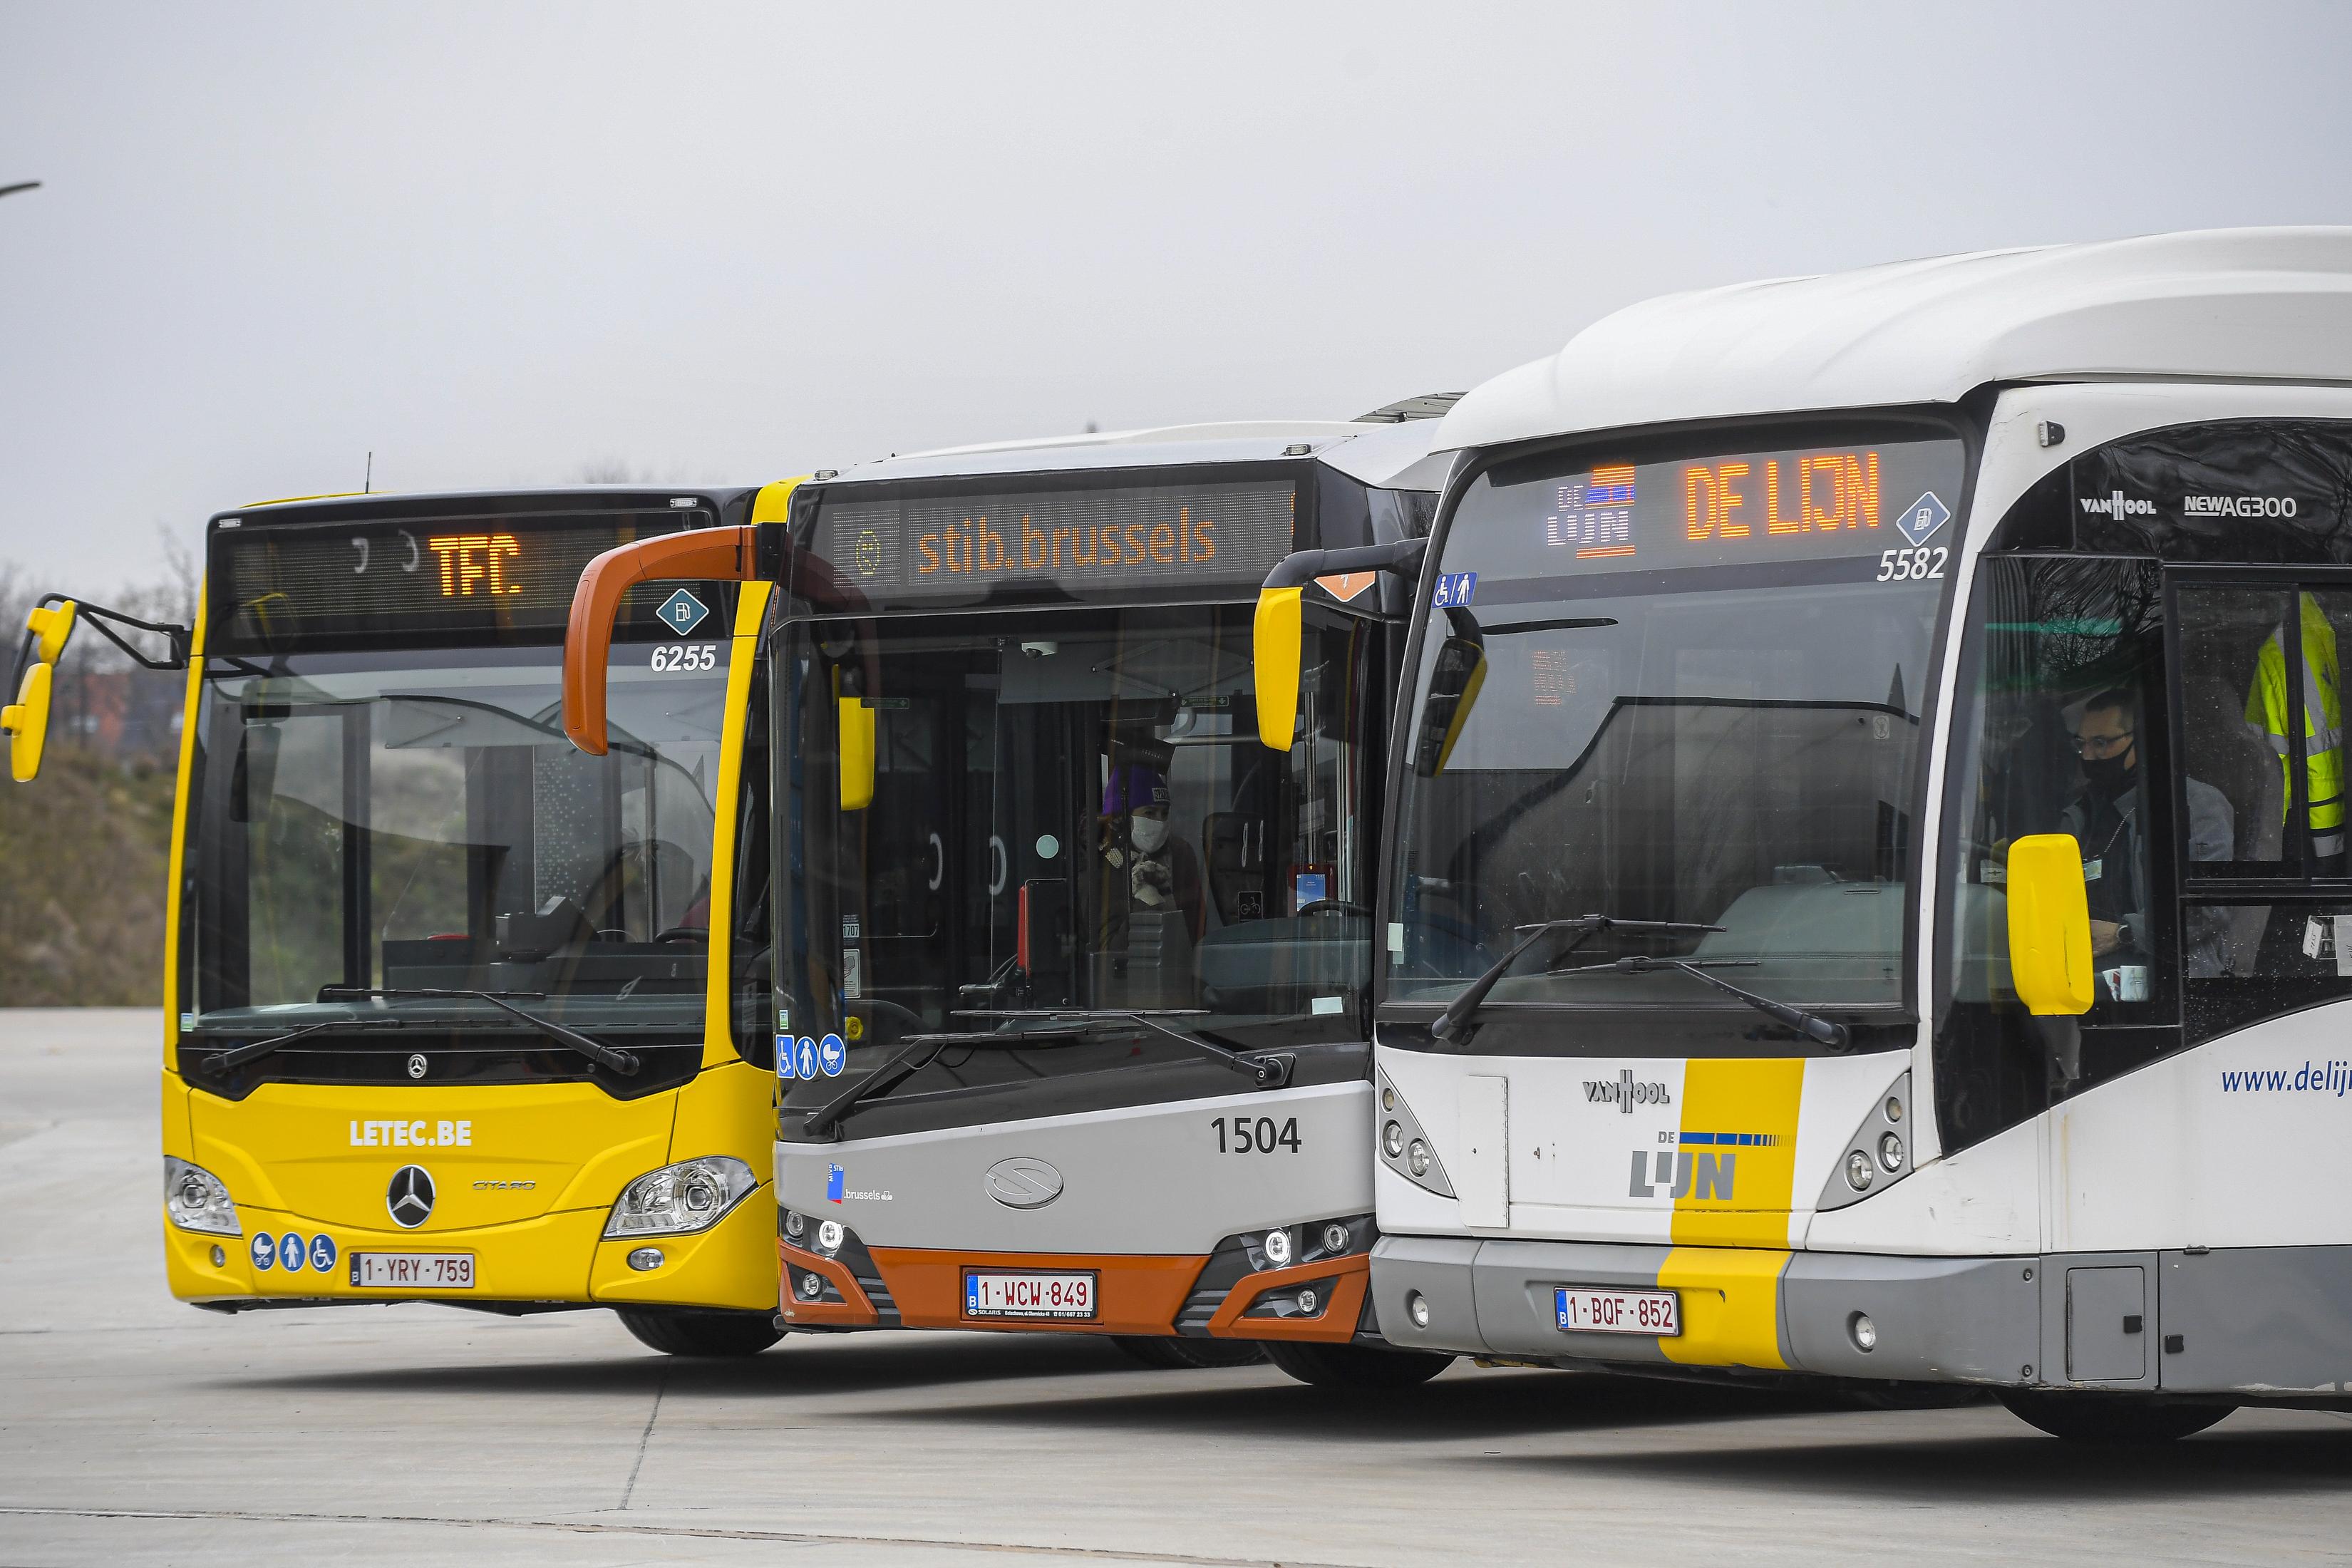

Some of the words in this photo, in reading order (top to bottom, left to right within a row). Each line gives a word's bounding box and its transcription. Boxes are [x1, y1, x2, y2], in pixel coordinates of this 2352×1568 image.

[1558, 485, 1584, 512] DE
[1687, 463, 1750, 540] DE
[1768, 452, 1879, 534] LIJN
[918, 506, 1216, 574] stib.brussels
[1547, 510, 1629, 546] LIJN
[1876, 546, 1949, 582] 5582
[651, 644, 716, 672] 6255
[350, 1120, 472, 1146] LETEC.BE
[1210, 1116, 1303, 1154] 1504
[1658, 1131, 1675, 1143] DE
[1629, 1150, 1736, 1200] LIJN
[352, 1272, 359, 1281] B
[969, 1296, 976, 1307] B
[1559, 1312, 1567, 1324] B
